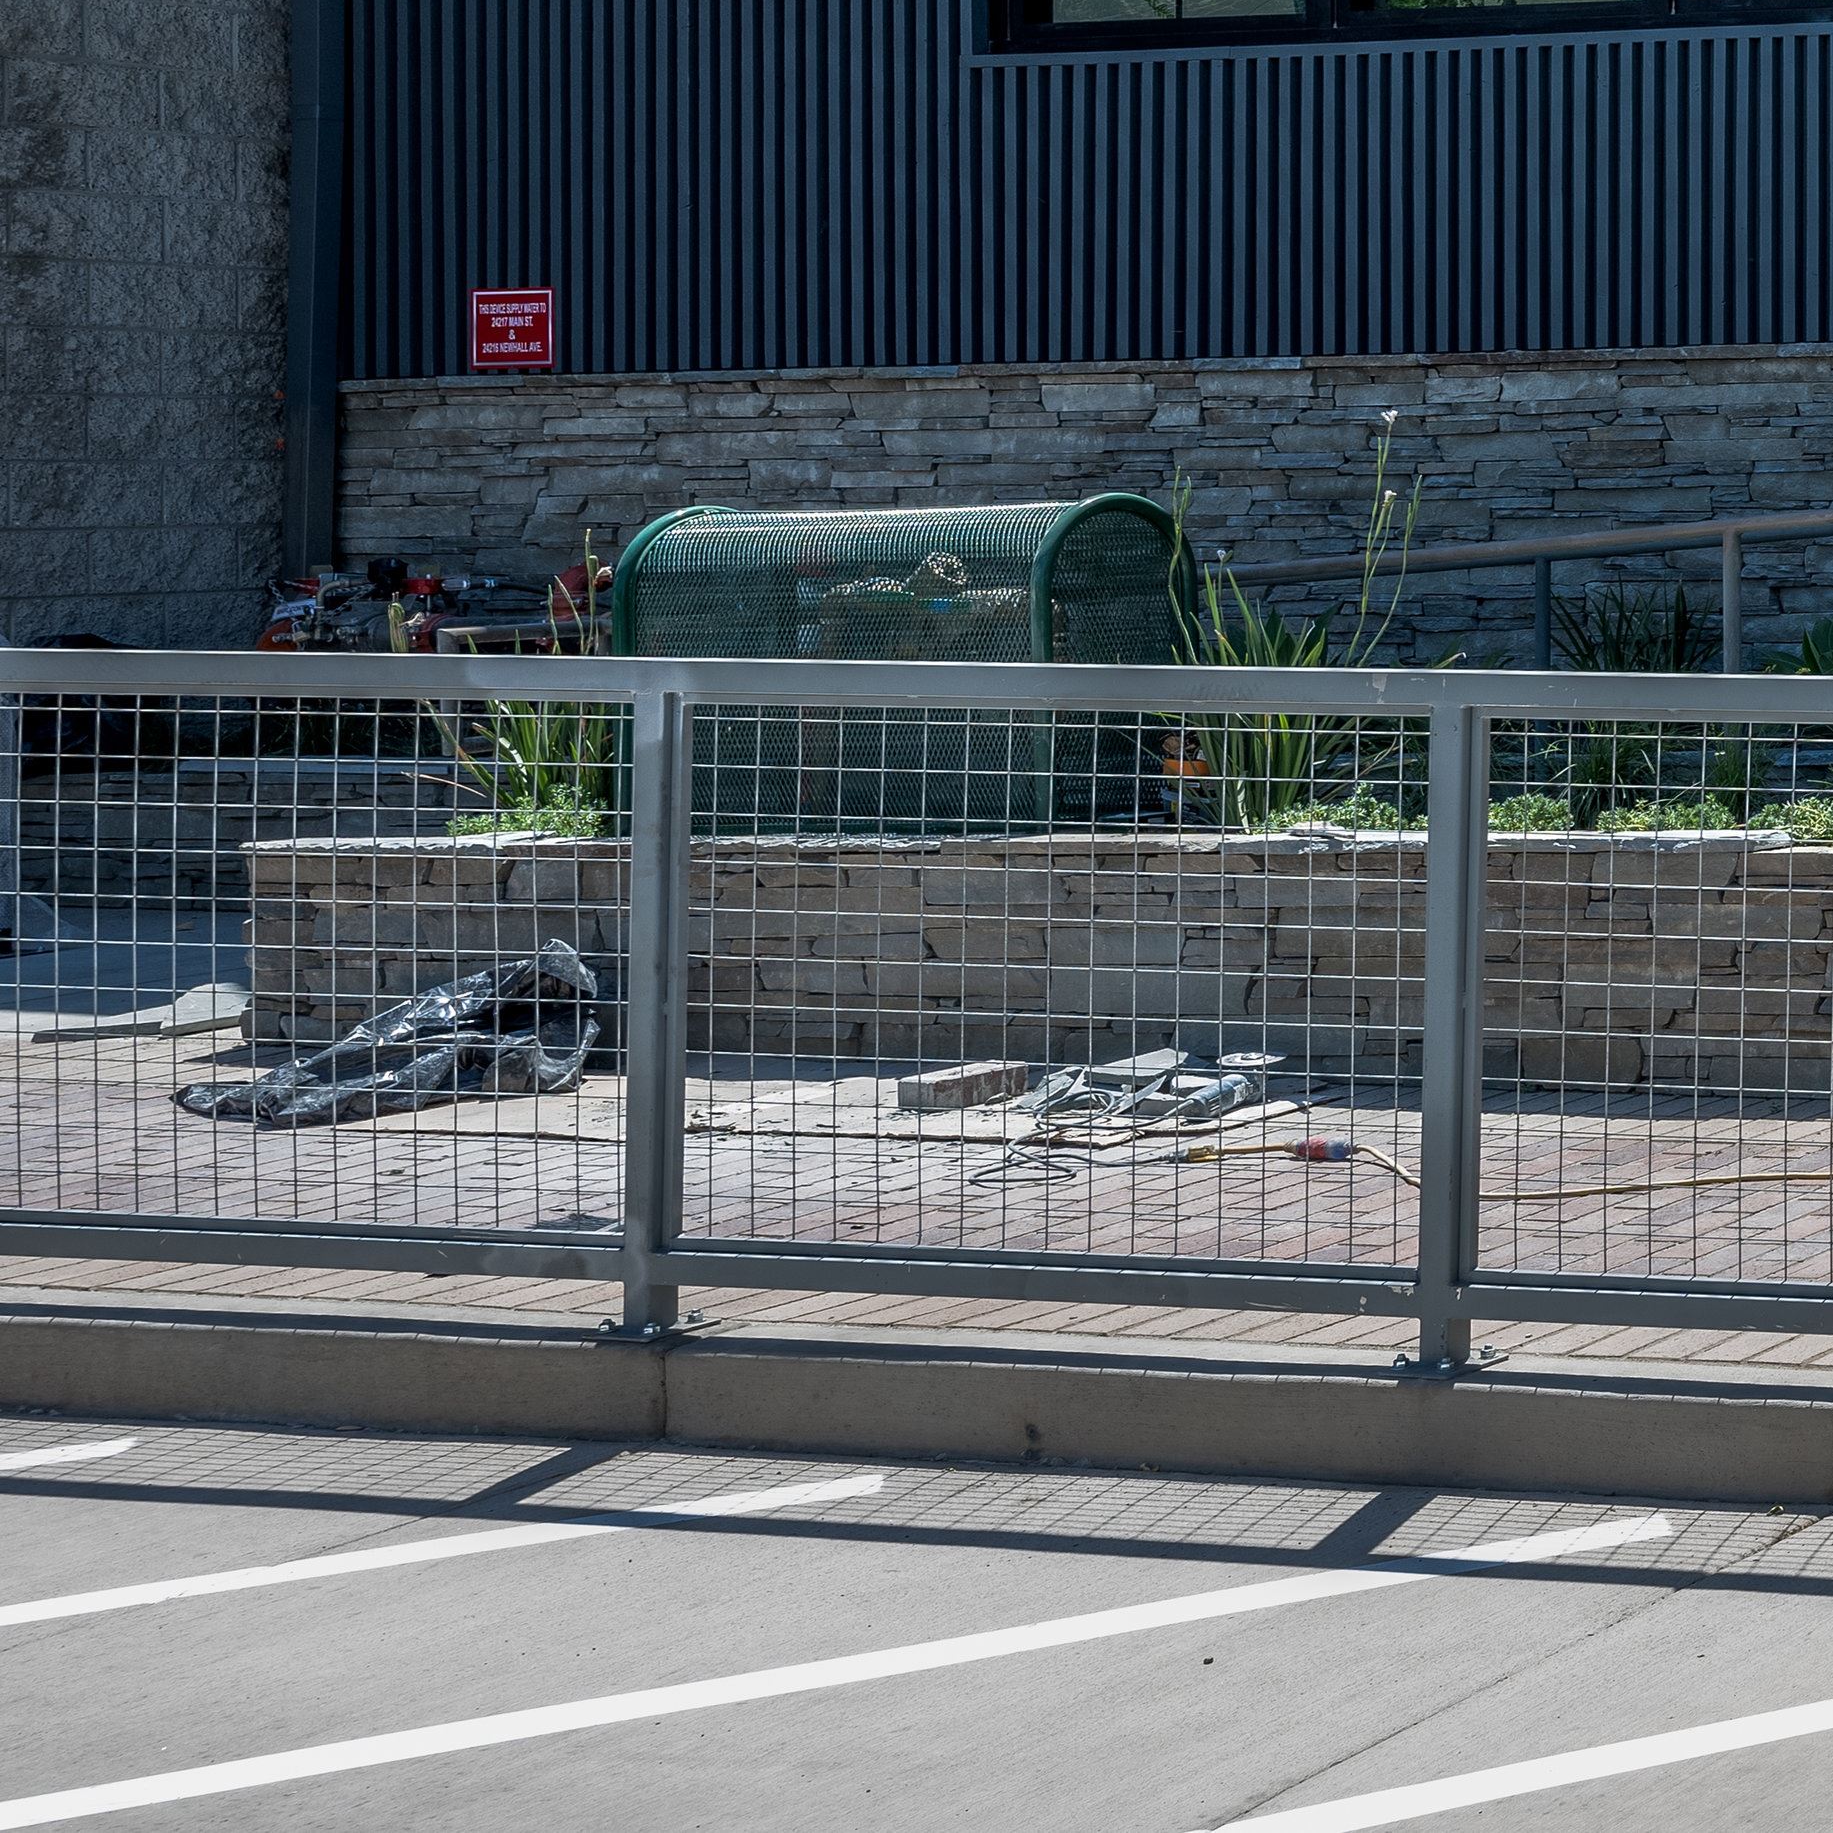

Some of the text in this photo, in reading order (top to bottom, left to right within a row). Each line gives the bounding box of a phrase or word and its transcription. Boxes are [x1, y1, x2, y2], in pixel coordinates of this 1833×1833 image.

[491, 317, 508, 327] 24217
[509, 316, 524, 326] MAIN
[508, 329, 516, 340] &
